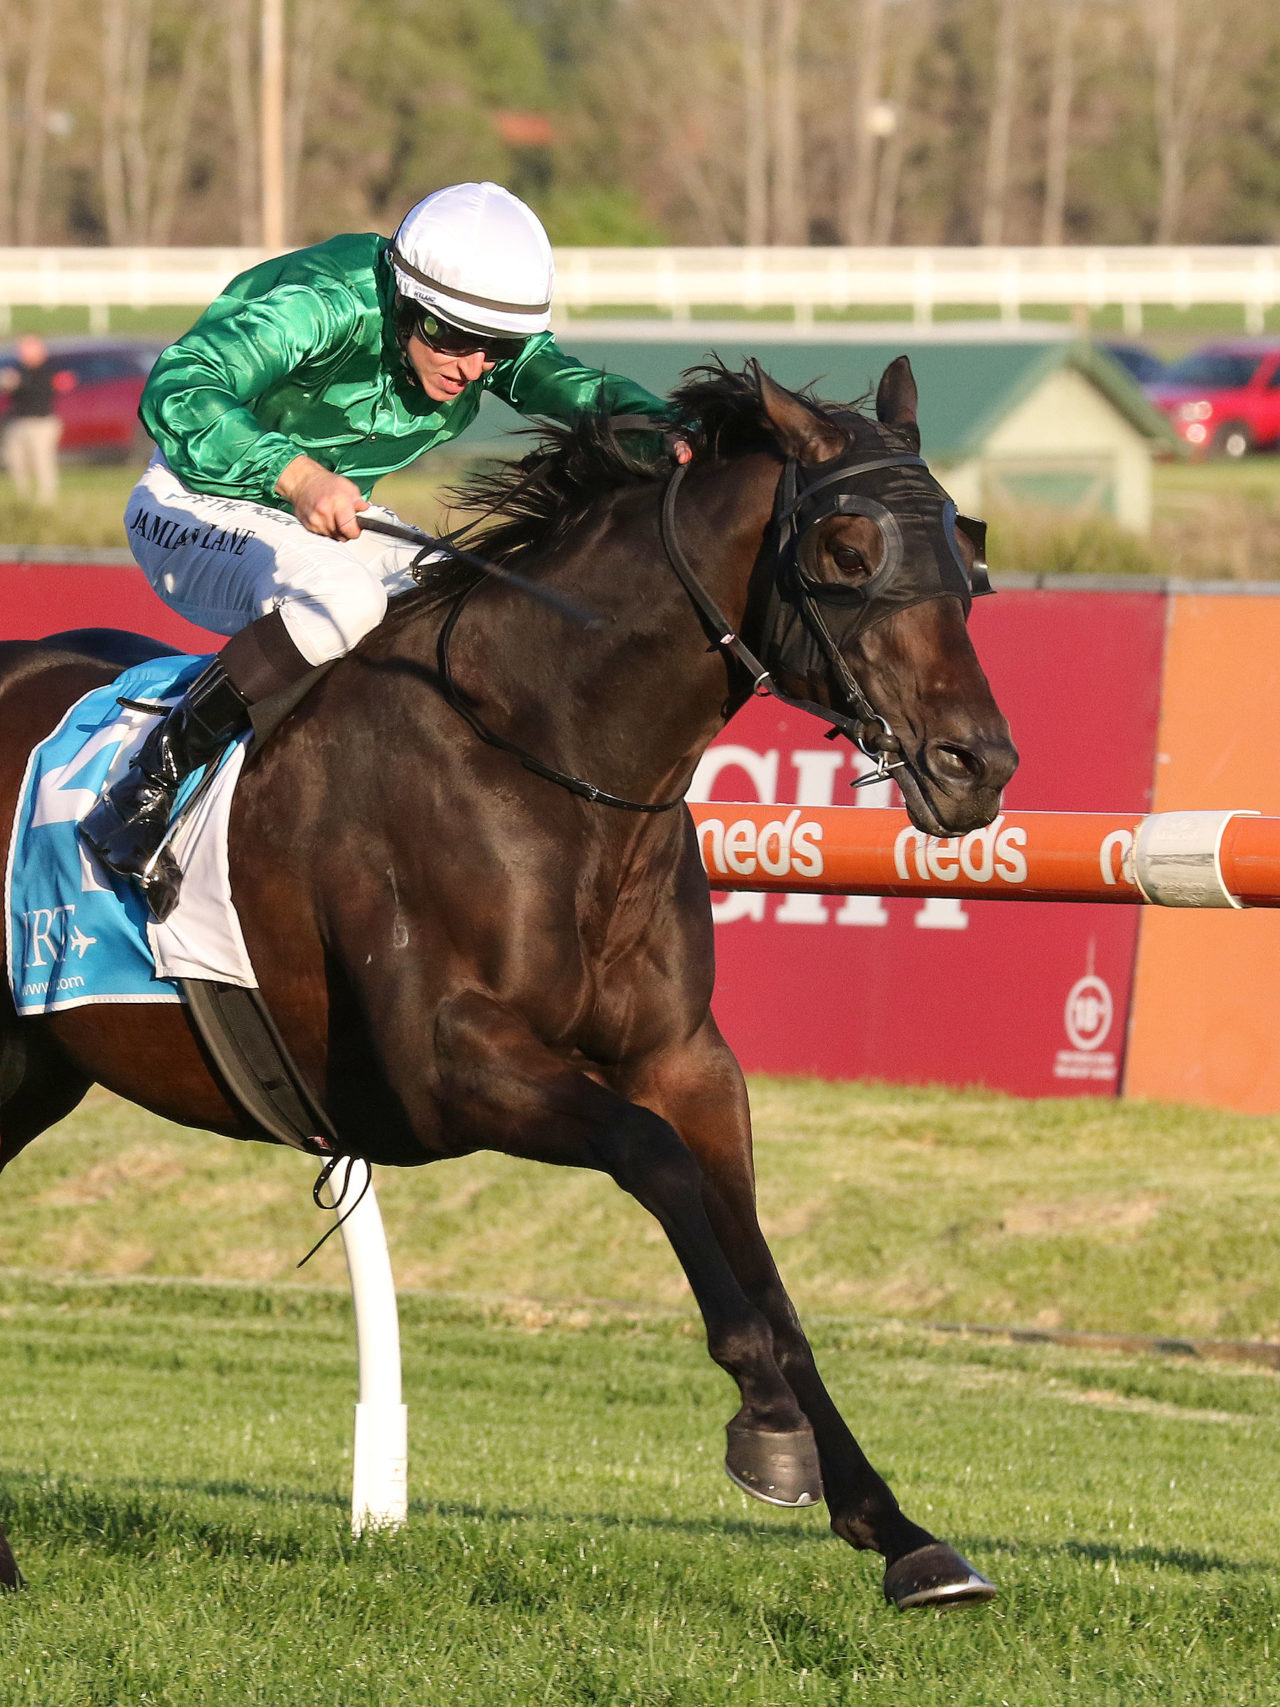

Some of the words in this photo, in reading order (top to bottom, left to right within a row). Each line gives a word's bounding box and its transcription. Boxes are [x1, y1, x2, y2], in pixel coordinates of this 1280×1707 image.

[200, 523, 256, 556] LANE
[696, 809, 824, 878] neds
[893, 814, 1028, 884] neds
